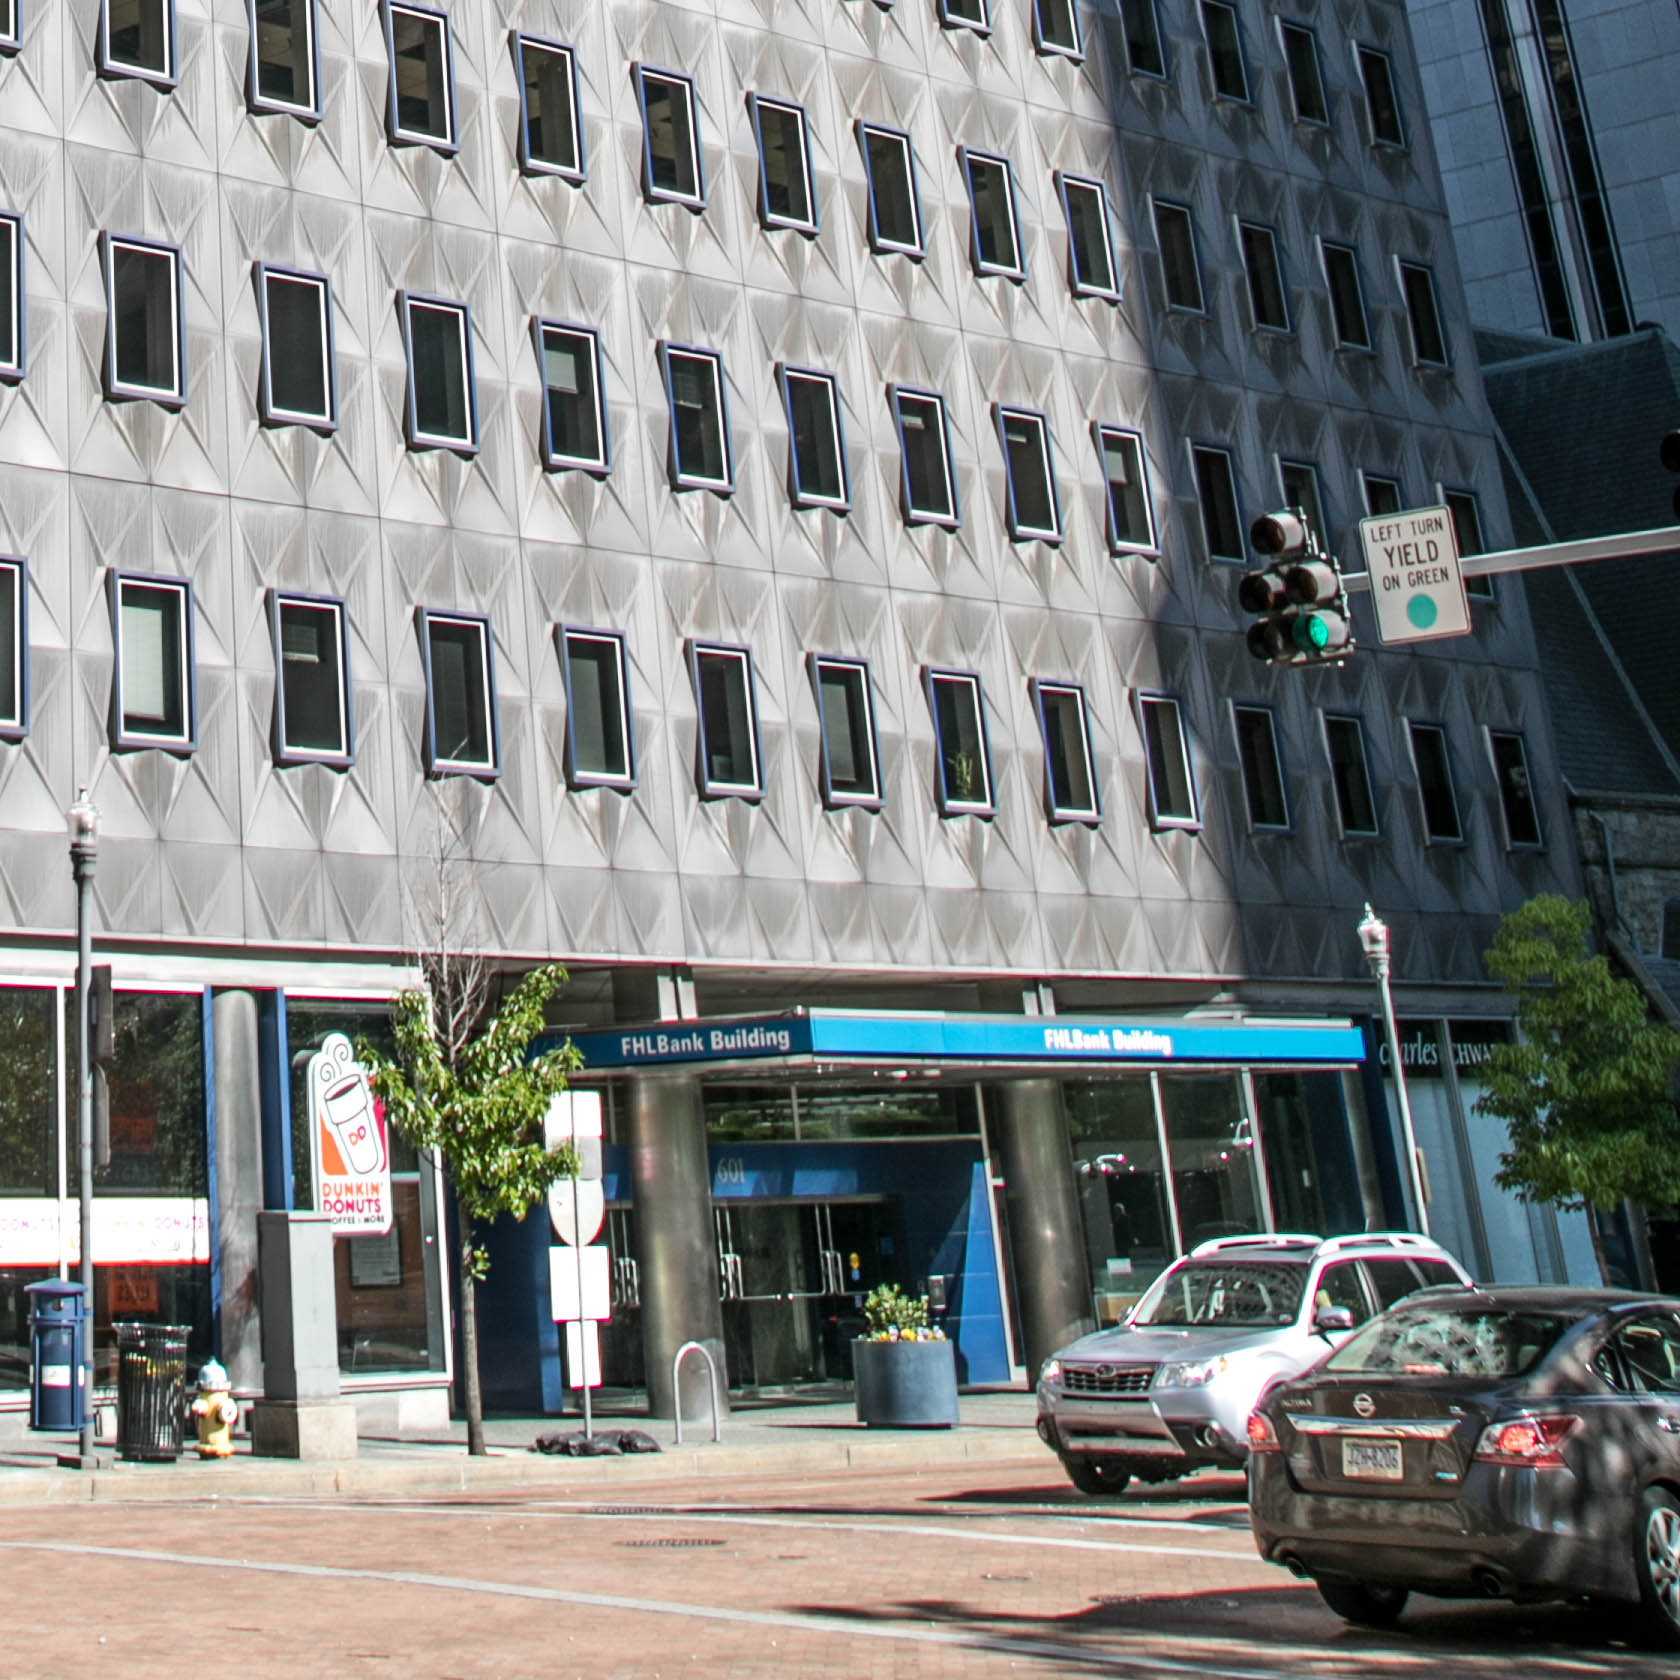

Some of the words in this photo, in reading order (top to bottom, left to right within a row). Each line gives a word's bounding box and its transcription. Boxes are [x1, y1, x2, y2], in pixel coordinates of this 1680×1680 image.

[1370, 523, 1401, 543] LEFT
[1411, 516, 1443, 536] TURN
[1383, 540, 1439, 568] YIELD
[1382, 574, 1401, 591] ON
[1407, 566, 1449, 587] GREEN
[621, 1032, 704, 1056] FHLBank
[710, 1027, 790, 1051] Building
[1043, 1028, 1110, 1050] FHLBank
[1112, 1029, 1173, 1057] Building
[1379, 1032, 1438, 1065] carles
[717, 1157, 745, 1184] 601
[322, 1182, 384, 1198] DUNKIN'
[323, 1198, 382, 1214] DONUTS
[330, 1217, 355, 1225] OFFEE
